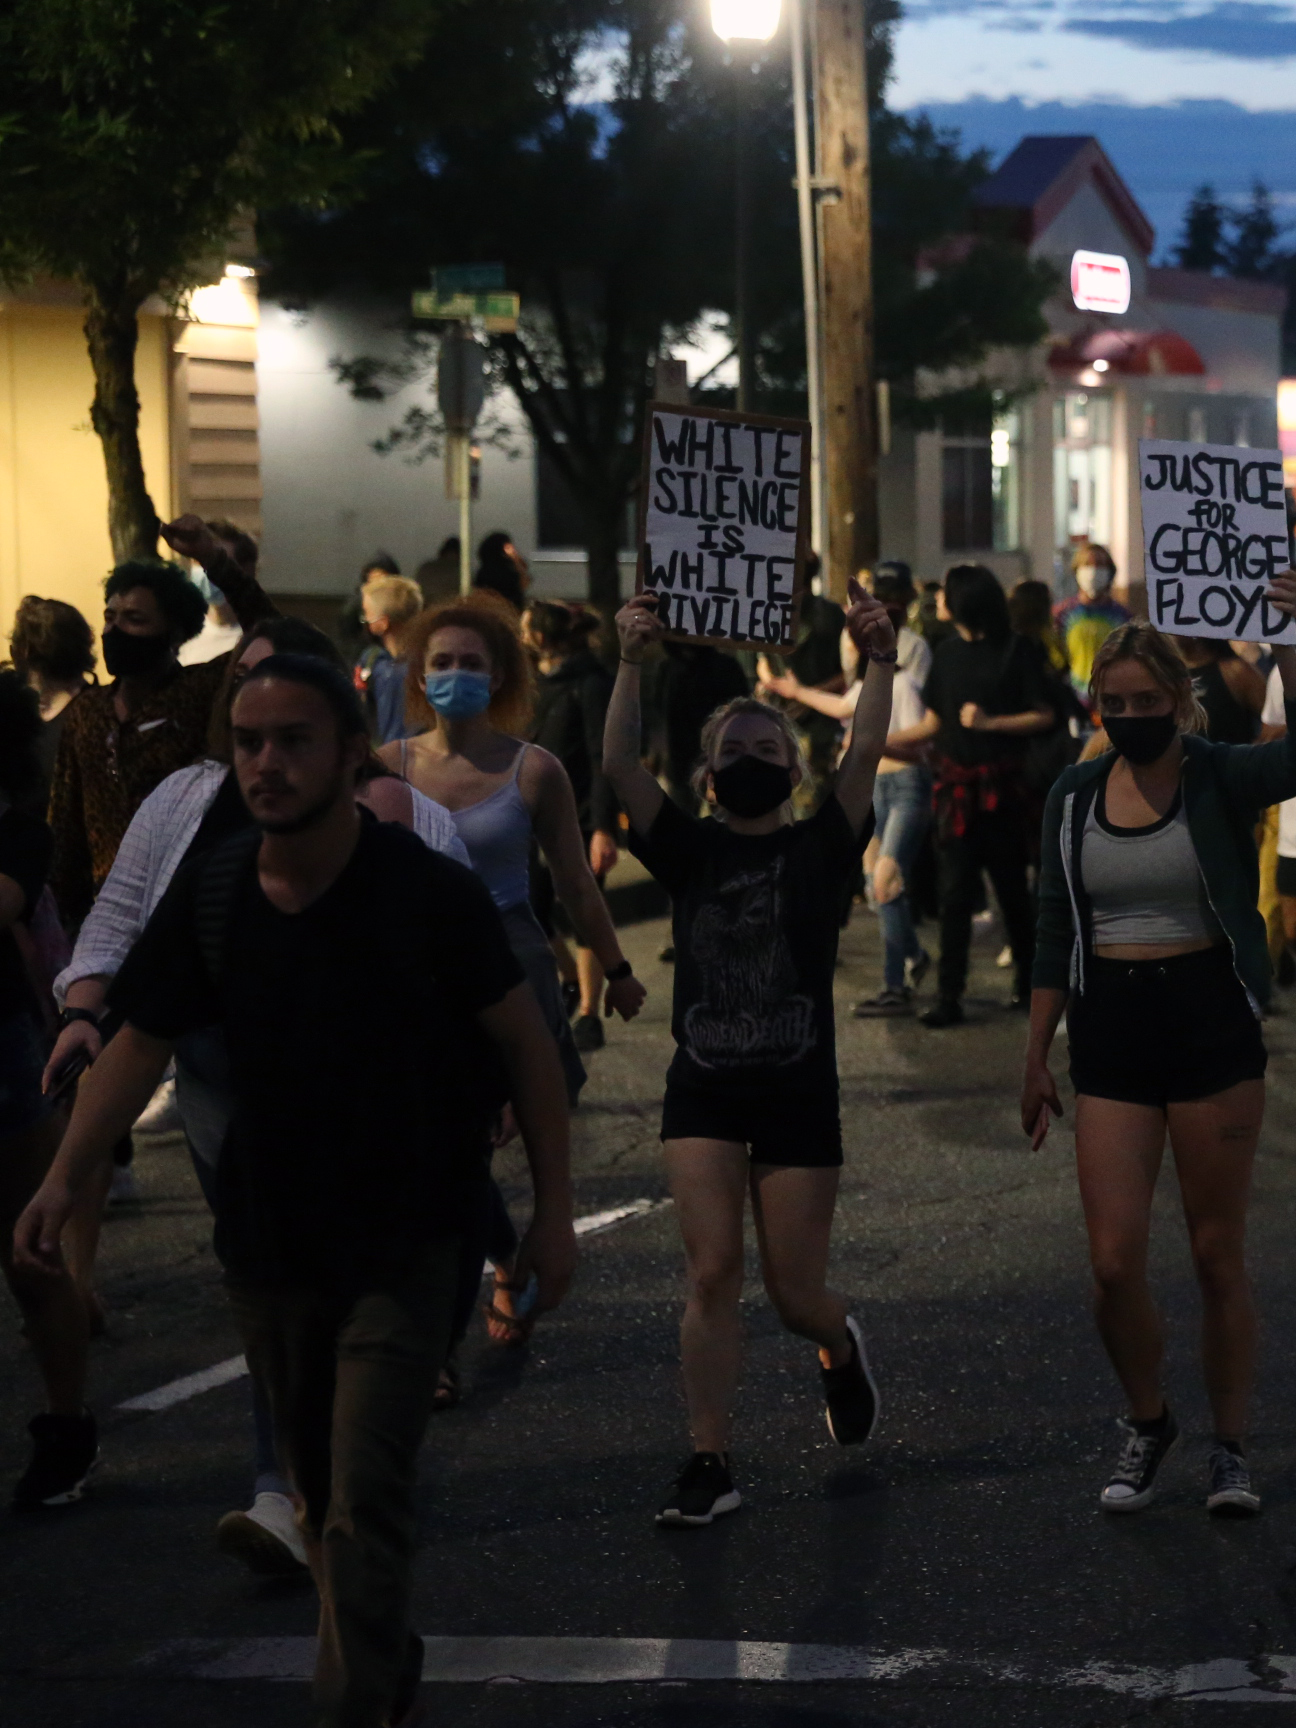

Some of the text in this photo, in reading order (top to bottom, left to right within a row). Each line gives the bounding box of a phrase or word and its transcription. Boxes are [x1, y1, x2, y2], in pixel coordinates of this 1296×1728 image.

[654, 416, 802, 479] WHITE
[654, 467, 800, 533] SILENCE
[1145, 451, 1284, 509] JUSTICE
[697, 524, 746, 553] IS
[1187, 499, 1240, 532] FOR
[643, 543, 796, 602] WHITE
[1150, 523, 1288, 581] GEORGE
[1156, 578, 1292, 637] FLOYD
